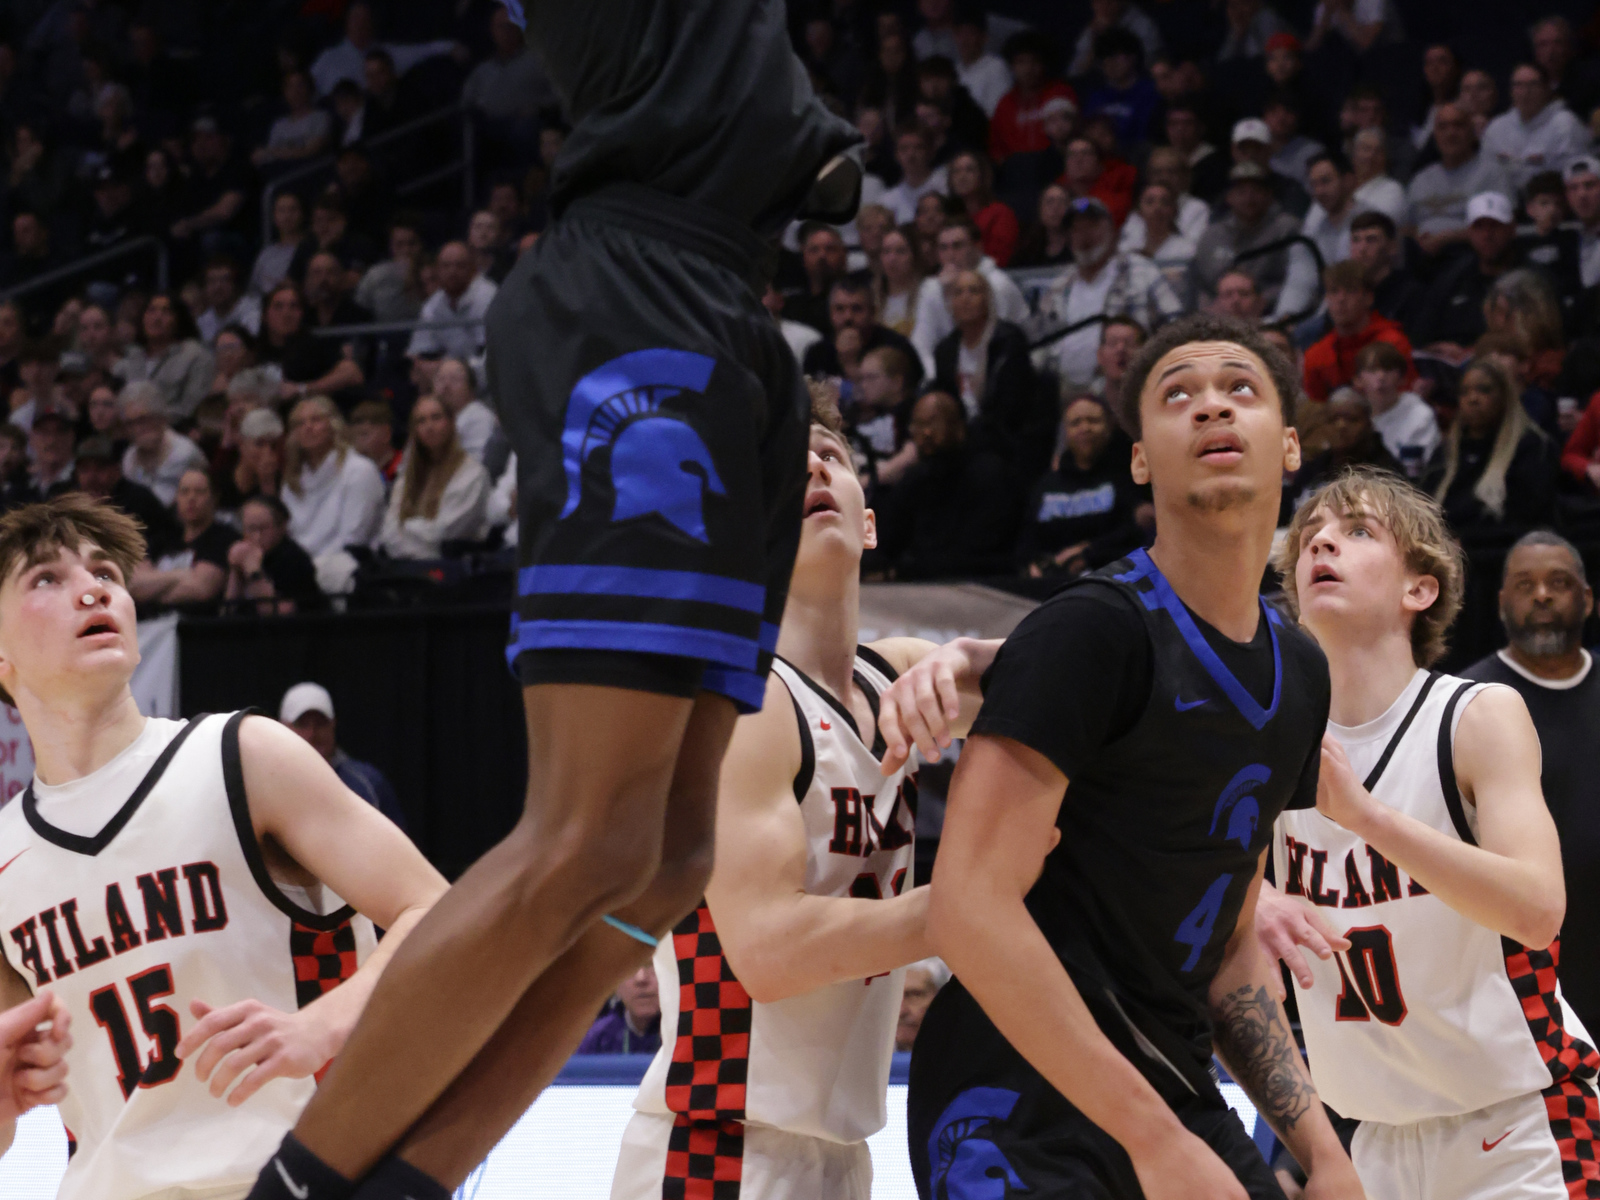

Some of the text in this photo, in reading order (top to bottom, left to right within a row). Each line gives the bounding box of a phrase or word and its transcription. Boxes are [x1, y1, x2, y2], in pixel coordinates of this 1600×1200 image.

[10, 861, 229, 987] HILAND
[1174, 872, 1234, 972] 4
[1335, 924, 1408, 1027] 10
[89, 963, 184, 1103] 15
